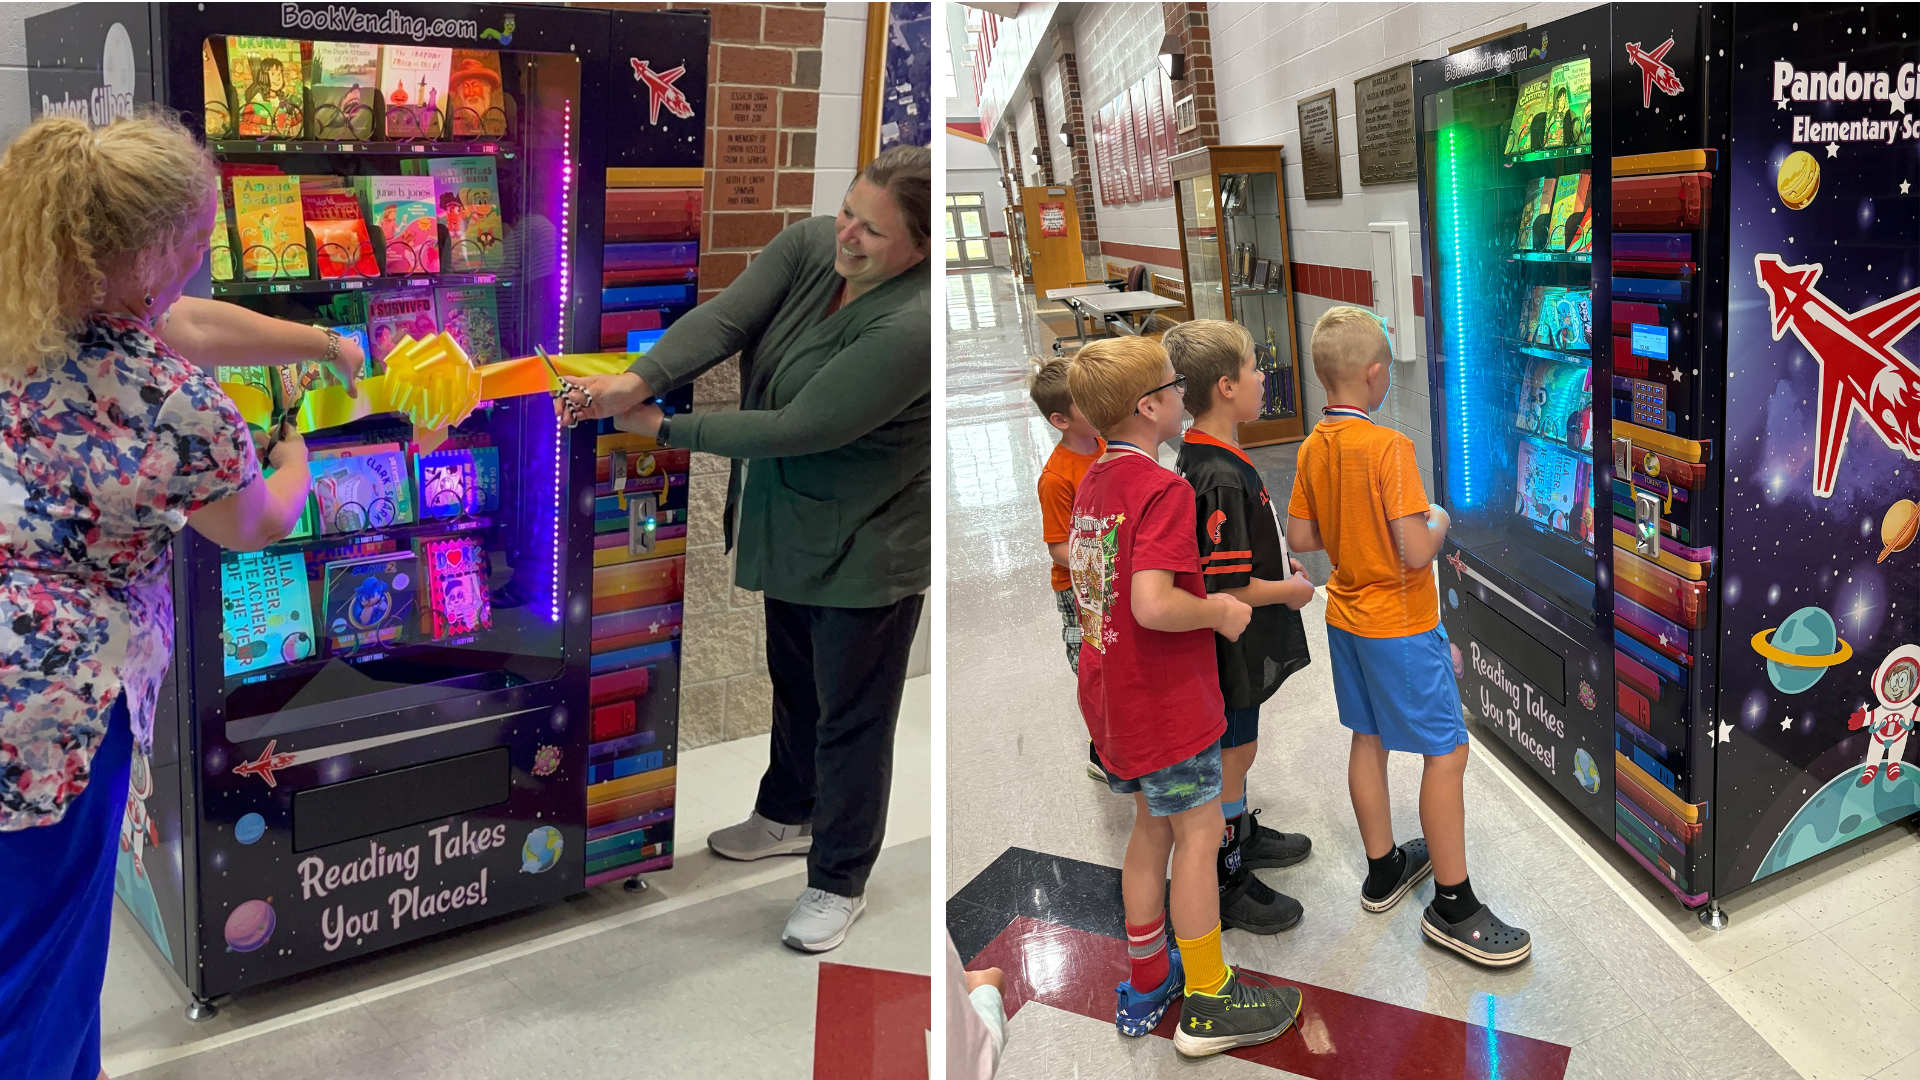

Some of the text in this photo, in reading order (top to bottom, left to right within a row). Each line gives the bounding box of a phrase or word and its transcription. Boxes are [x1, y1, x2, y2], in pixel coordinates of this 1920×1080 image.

[281, 2, 477, 42] BookVending.com
[1444, 45, 1528, 82] BookVending.com
[1772, 60, 1890, 102] Pandora
[41, 84, 134, 126] Pandora Gilboa
[1524, 81, 1542, 96] KATIE
[735, 134, 758, 142] MEMORY
[1792, 114, 1900, 146] Elementary
[375, 187, 396, 200] junie
[398, 187, 406, 196] b.
[406, 188, 431, 200] jones
[376, 299, 432, 316] SURVIVED
[366, 457, 392, 485] CLARK
[1644, 476, 1662, 488] TOKENS
[351, 562, 386, 576] SONIC
[226, 561, 254, 668] OF THE YEAR
[244, 558, 268, 636] TEACHER
[1470, 641, 1566, 739] Reading Takes
[1480, 685, 1556, 776] You Places!
[297, 820, 506, 901] Reading Takes
[321, 867, 489, 952] You Places!
